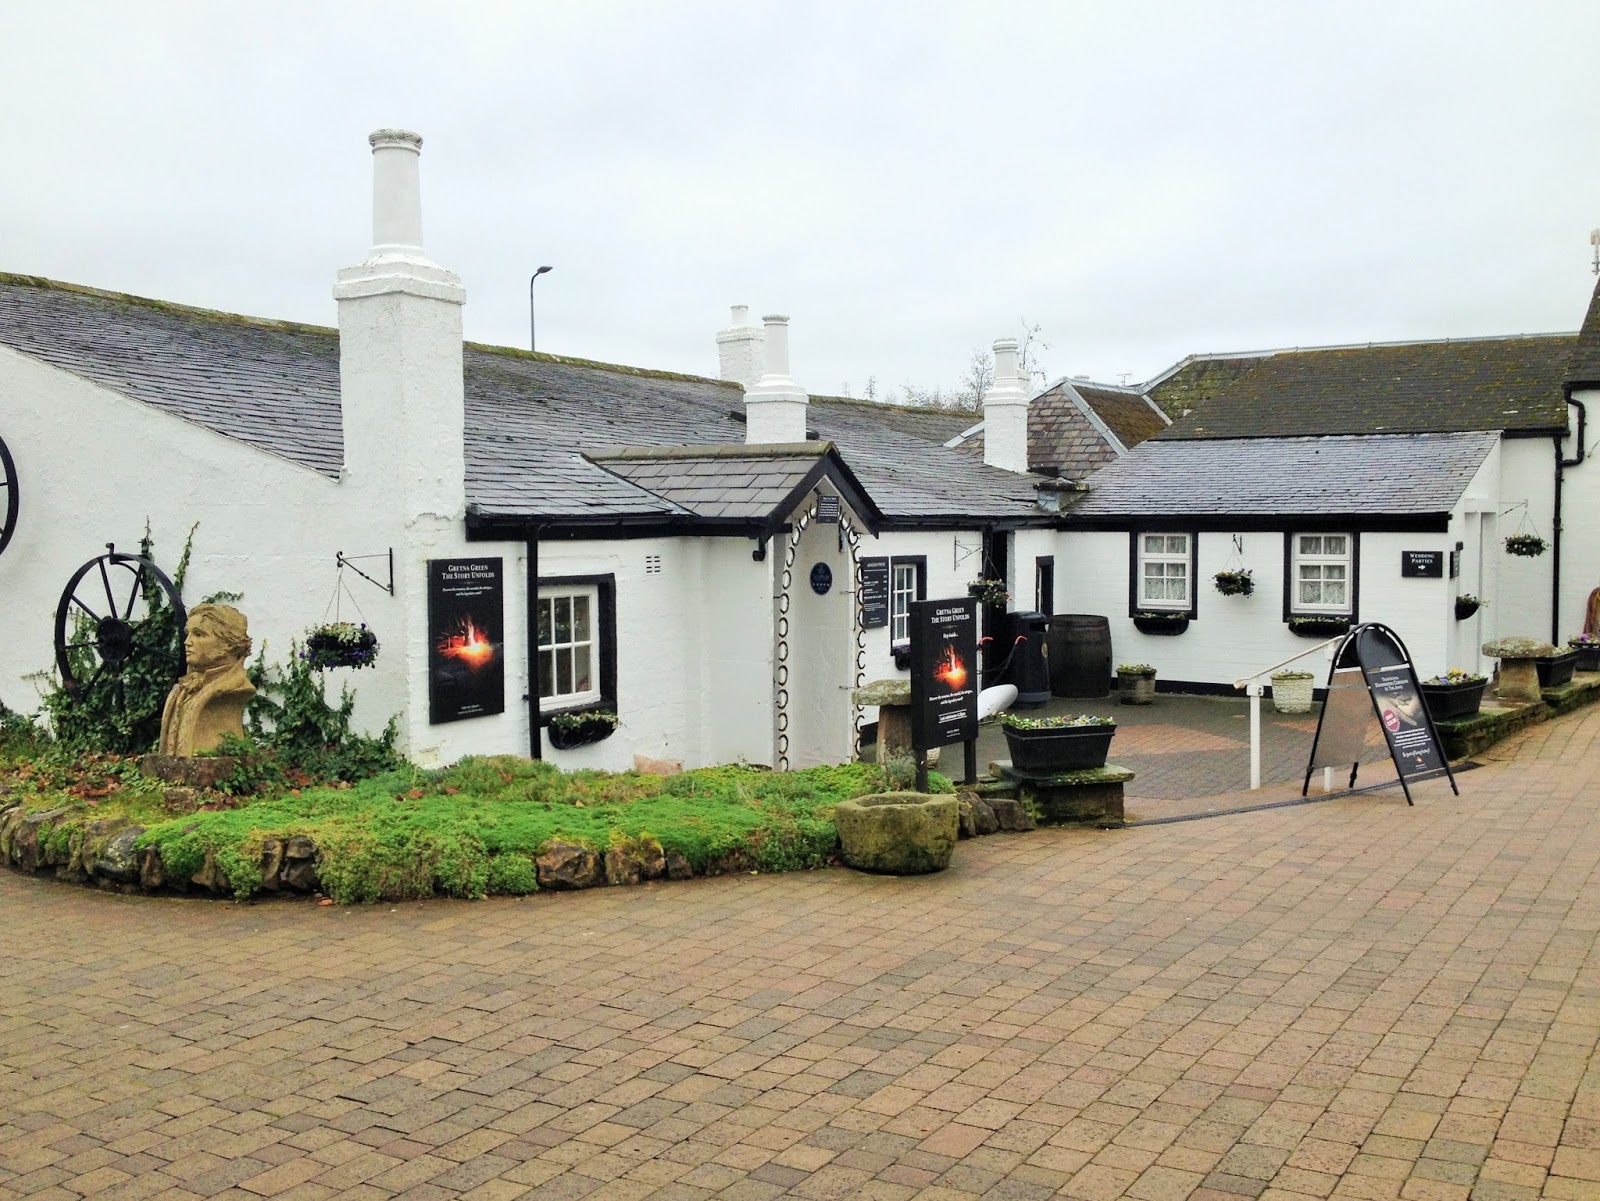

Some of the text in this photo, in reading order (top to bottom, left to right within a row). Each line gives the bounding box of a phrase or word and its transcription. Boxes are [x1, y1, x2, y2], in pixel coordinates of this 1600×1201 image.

[448, 563, 489, 572] GRETNA GREEN
[441, 572, 453, 580] THE
[471, 571, 495, 579] UNFOLDS
